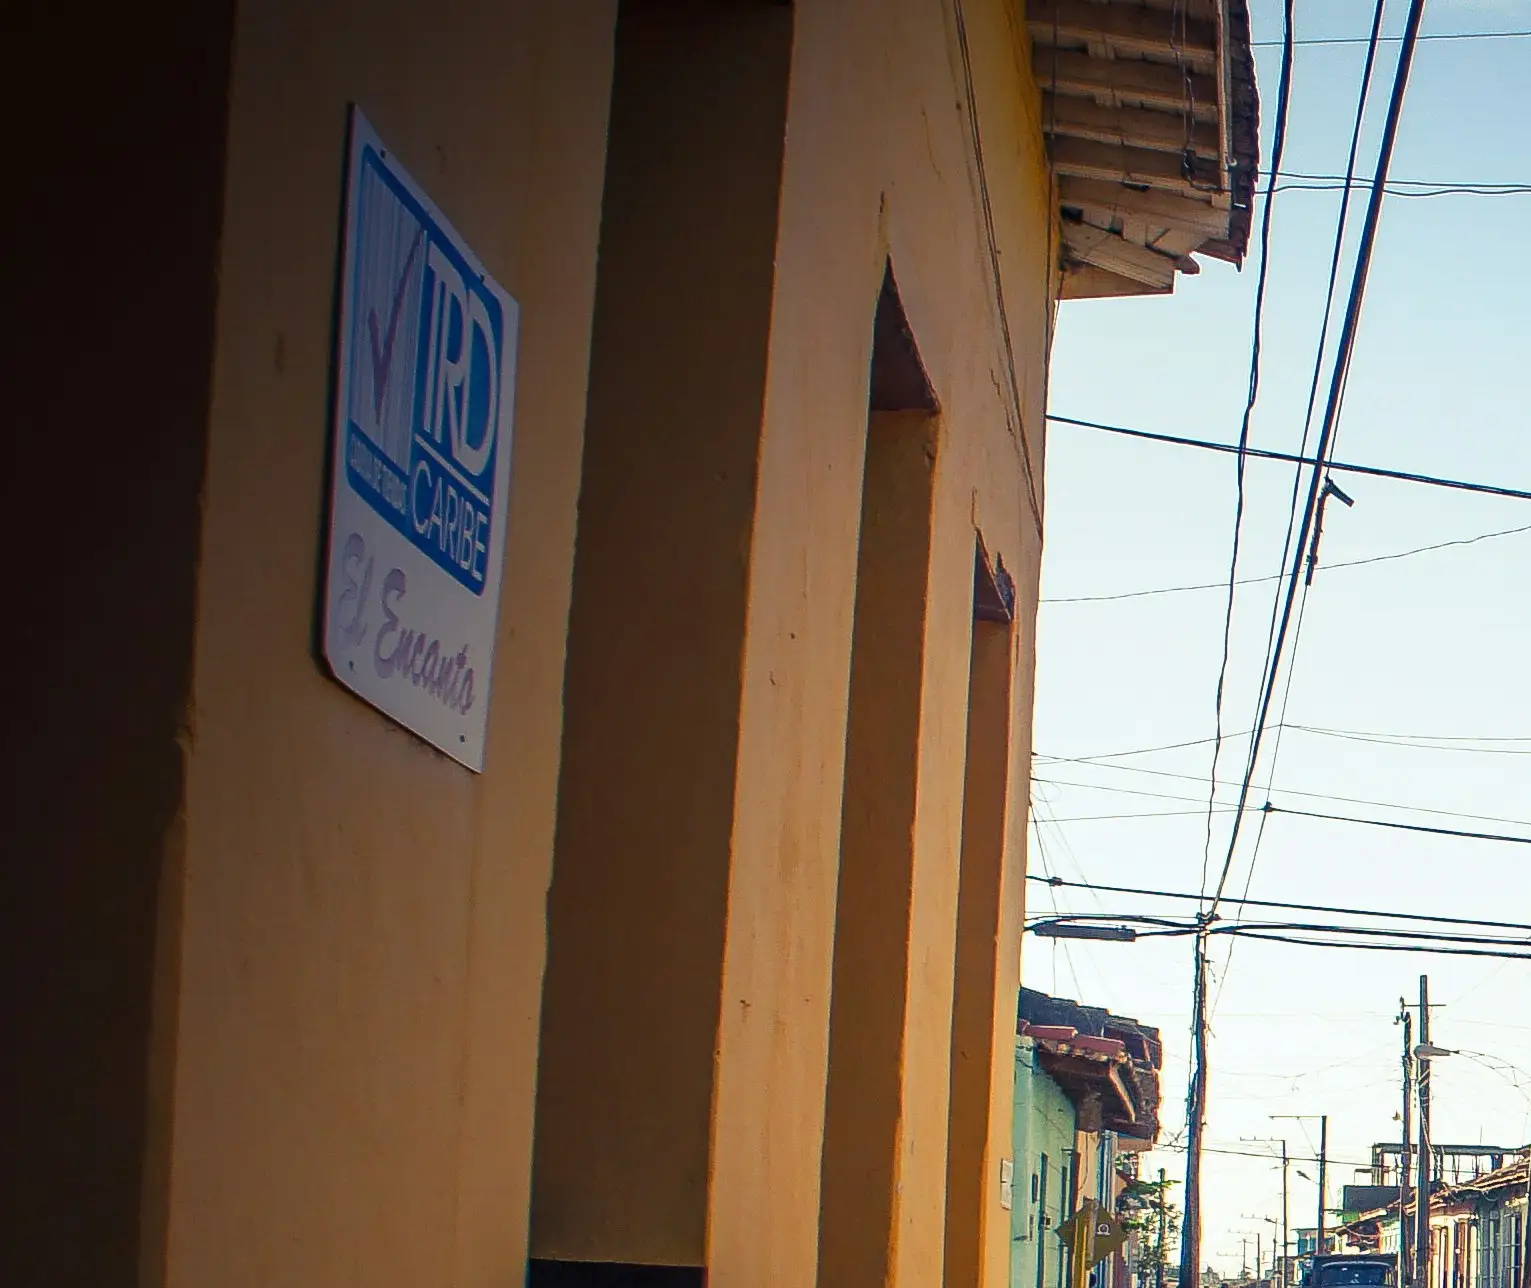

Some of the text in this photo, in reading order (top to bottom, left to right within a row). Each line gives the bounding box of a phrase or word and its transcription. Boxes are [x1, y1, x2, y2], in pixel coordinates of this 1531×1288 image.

[424, 241, 497, 476] TRD
[413, 460, 488, 581] CARIBE
[337, 532, 476, 715] El Encanto
